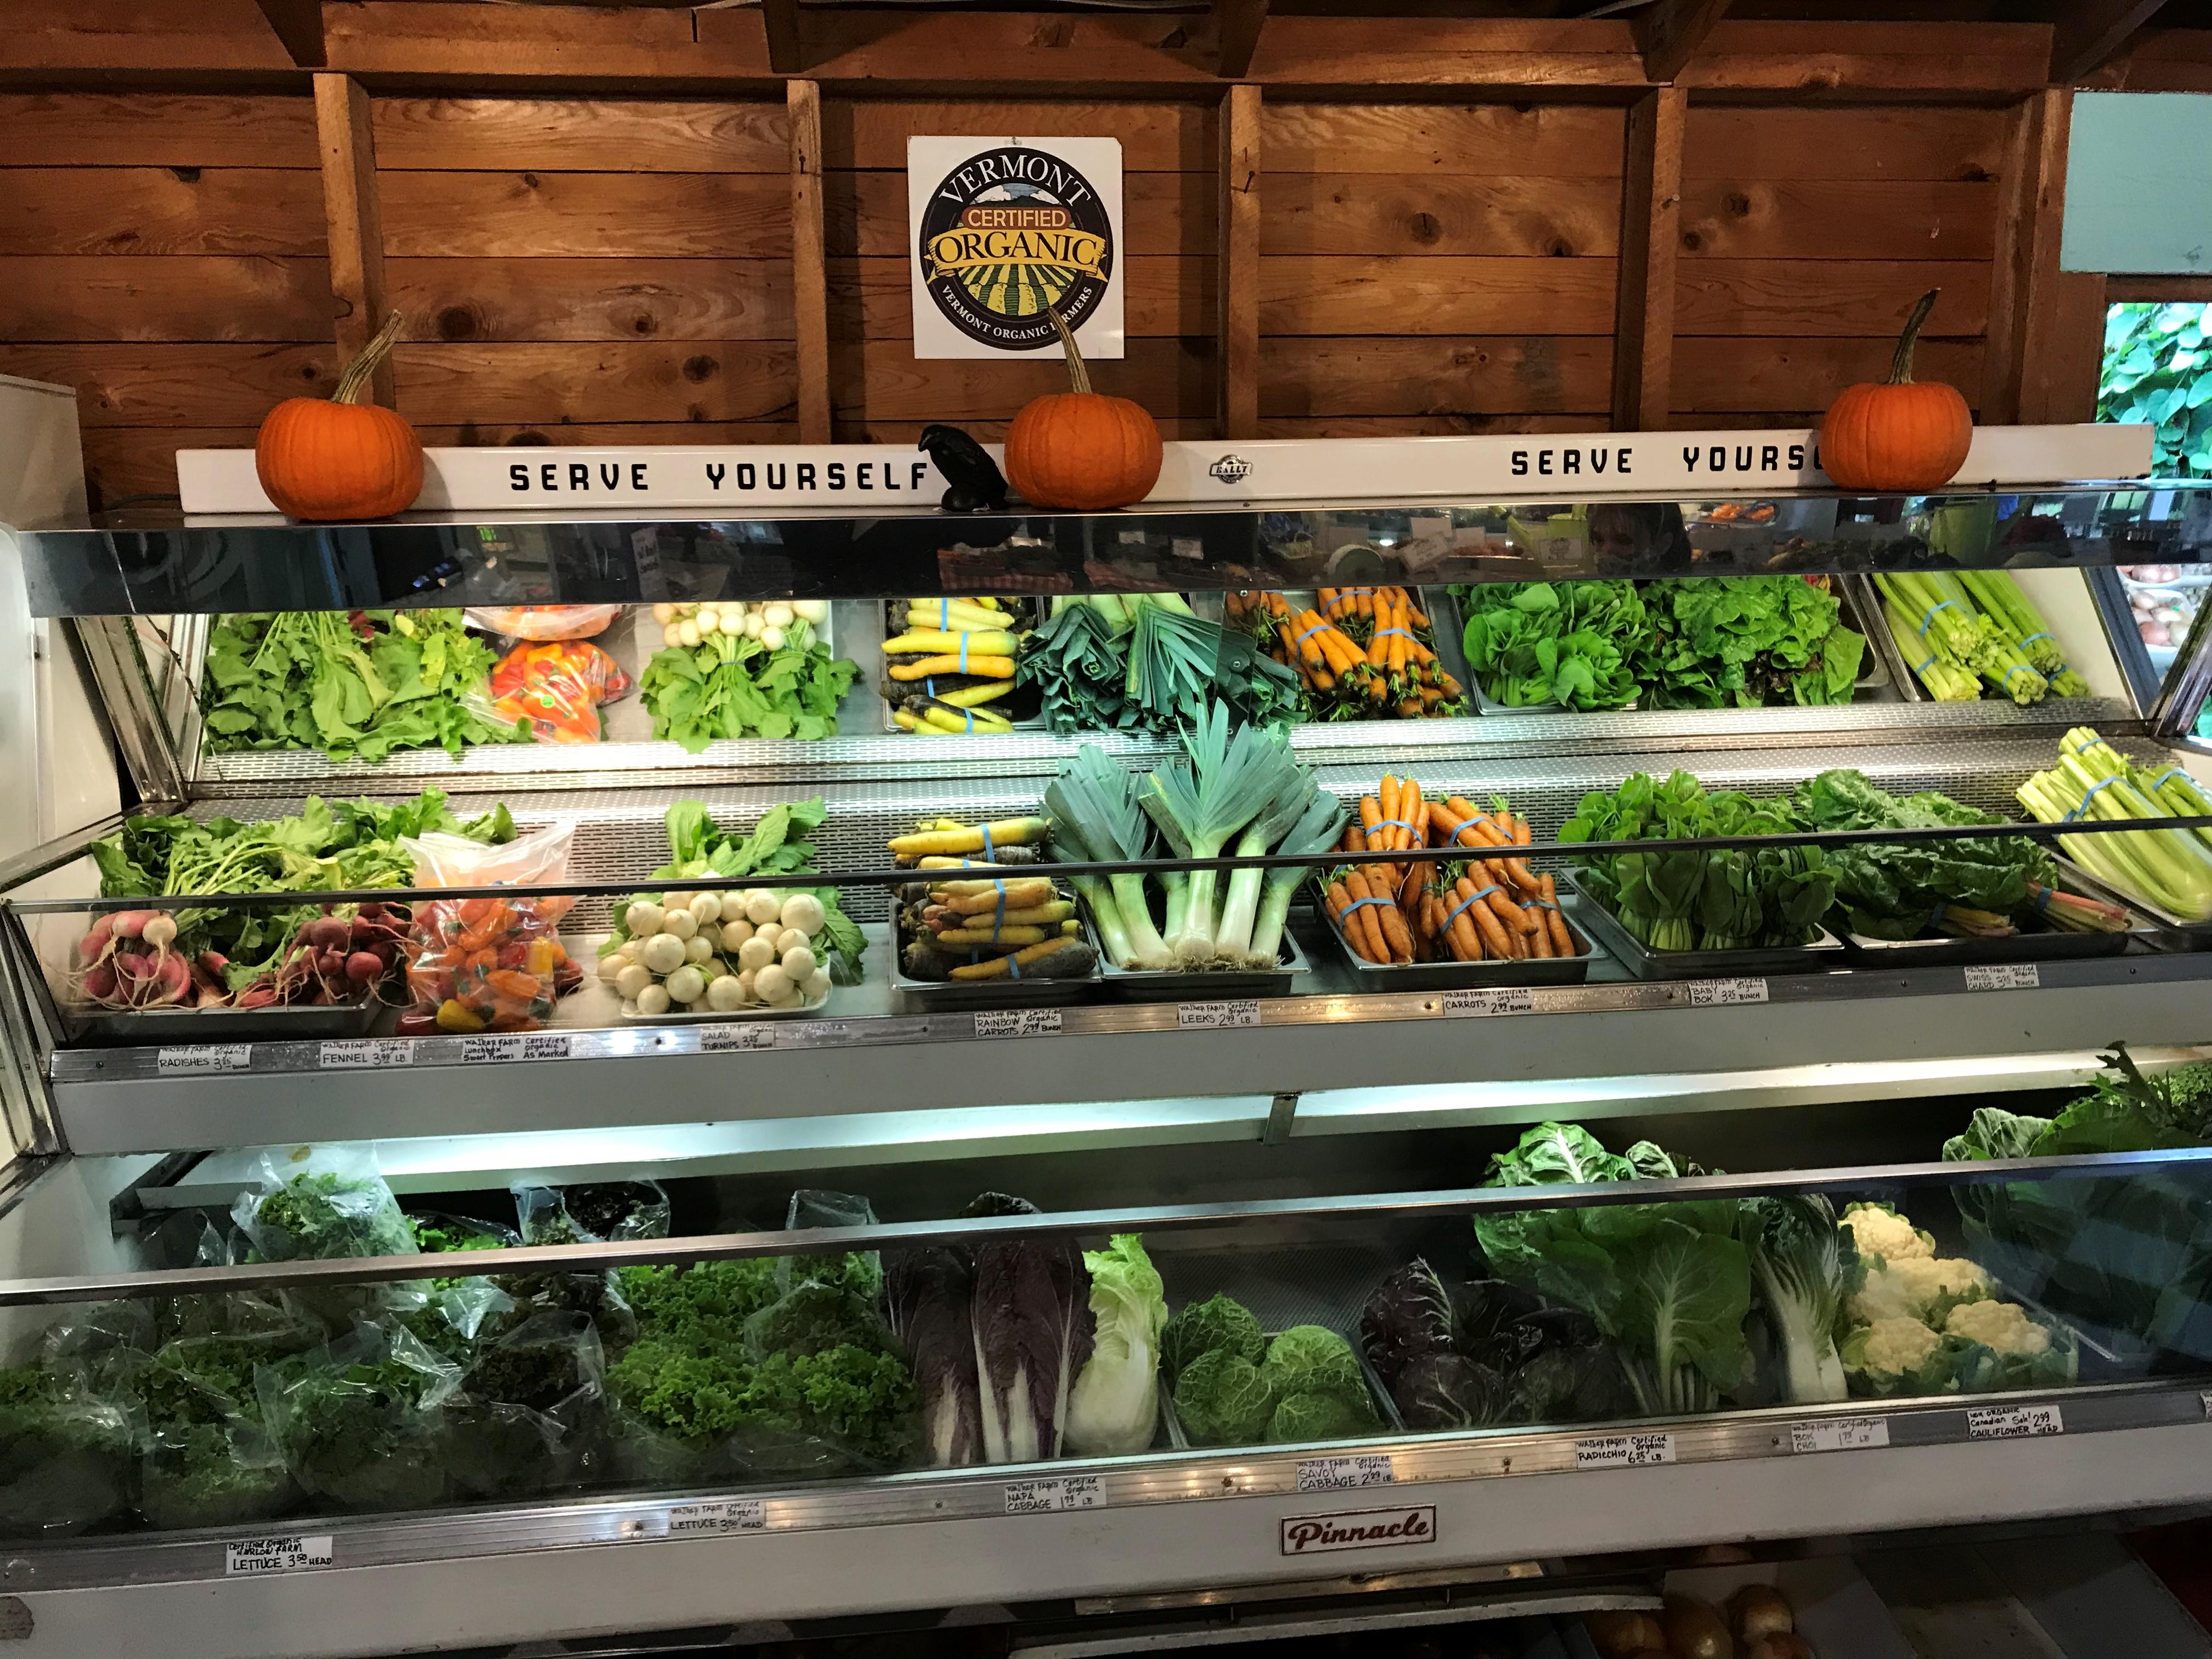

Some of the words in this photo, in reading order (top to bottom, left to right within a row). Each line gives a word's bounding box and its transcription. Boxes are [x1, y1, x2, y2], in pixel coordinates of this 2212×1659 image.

[939, 155, 1091, 207] VERMONT
[968, 210, 1066, 227] CERTIFIED
[935, 231, 1097, 266] ORGANIC
[941, 285, 991, 332] VERMONT
[994, 326, 1049, 339] ORGANIC
[1047, 286, 1092, 331] RMERS
[1511, 448, 1632, 475] SERVE
[511, 464, 648, 490] SERVE
[707, 462, 927, 490] YOURSELF
[1691, 985, 1717, 995] BABY
[1968, 982, 1994, 990] CHARD
[1446, 1000, 1486, 1009] CARROTS
[1694, 995, 1713, 1003] BOK
[977, 1017, 1020, 1027] RAINBOW
[1182, 1015, 1215, 1024] LEEKS
[702, 1032, 730, 1040] SALAD
[978, 1027, 1018, 1036] CARROTS
[702, 1041, 739, 1050] TURNIPS
[160, 1058, 210, 1067] RADISHES
[323, 1054, 368, 1063] FENNEL
[1971, 1426, 2030, 1437] CAULIFLOWER
[1578, 1450, 1627, 1462] RADICCHIO
[1298, 1467, 1336, 1479] SAVOY
[1299, 1476, 1356, 1488] CABBAGE
[1007, 1492, 1034, 1502] NAPA
[1007, 1499, 1051, 1511] CABBAGE
[670, 1519, 716, 1530] LETTUCE
[1289, 1512, 1429, 1549] Pinnacle
[233, 1557, 282, 1570] LETTUCE
